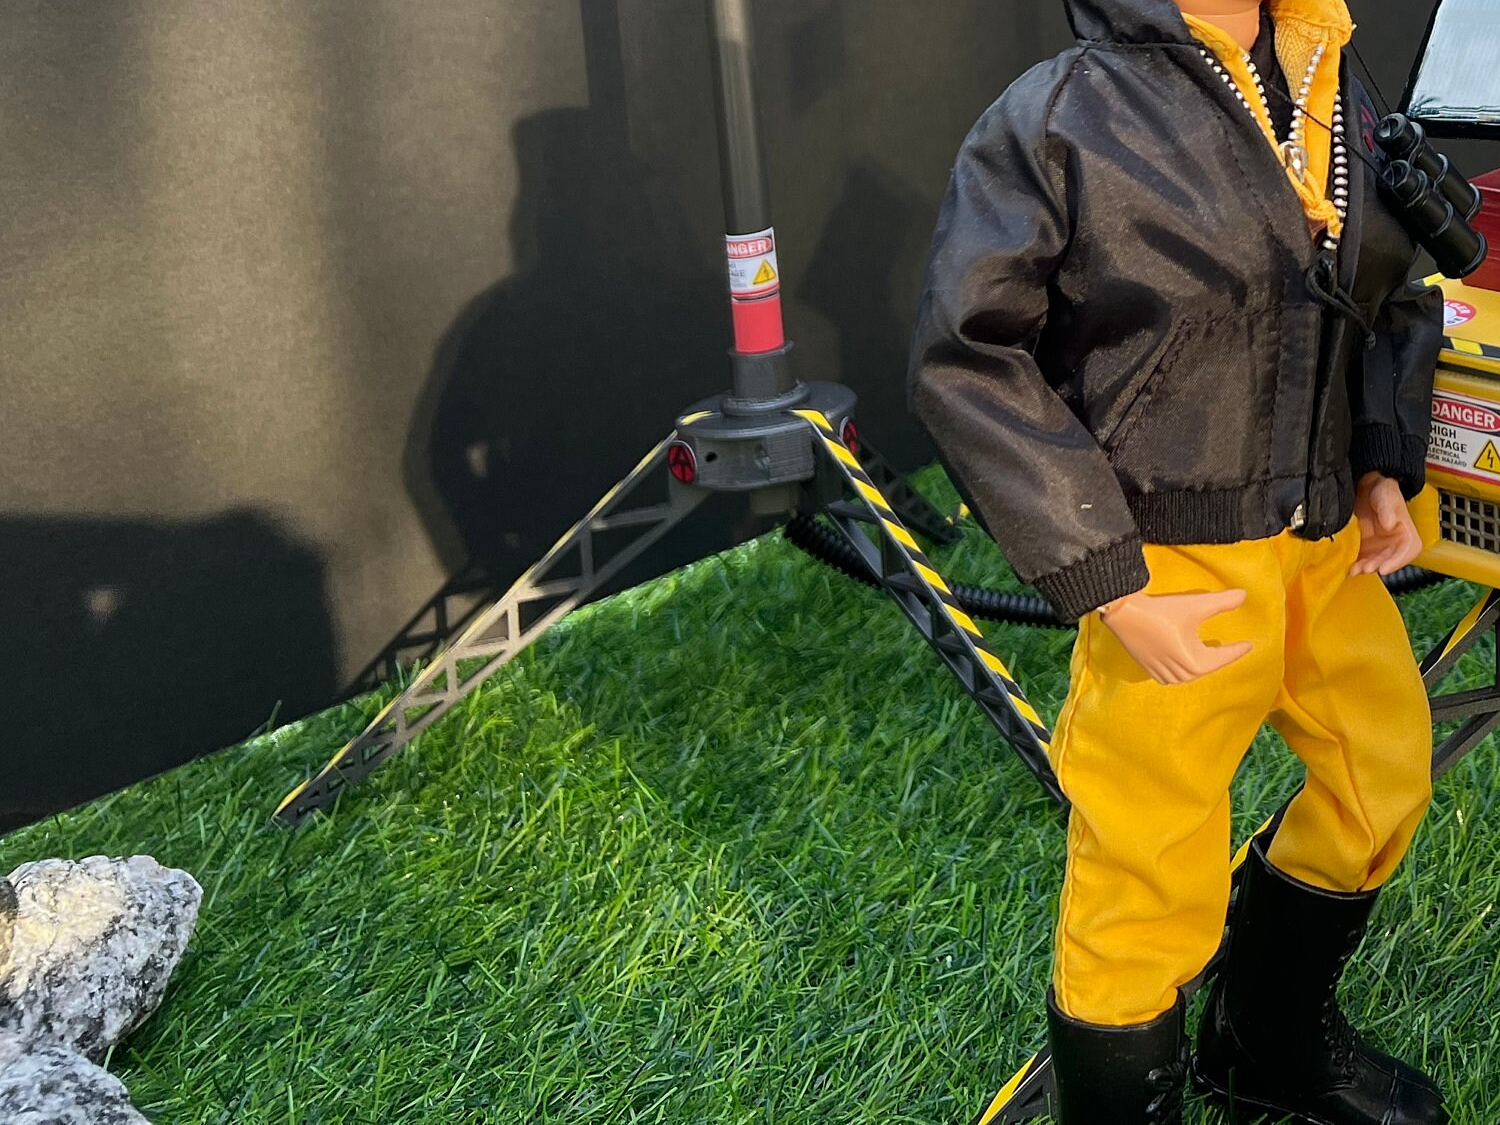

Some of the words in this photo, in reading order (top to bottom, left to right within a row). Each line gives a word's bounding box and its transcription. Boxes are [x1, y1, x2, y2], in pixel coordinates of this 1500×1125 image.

[727, 239, 768, 256] NGER
[1432, 400, 1496, 429] DANGER
[1430, 424, 1457, 439] HIGH
[1428, 435, 1468, 453] OLTAGE
[1427, 453, 1441, 461] OCK
[1442, 456, 1468, 467] HAZARD
[1429, 447, 1460, 460] LECTRICAL
